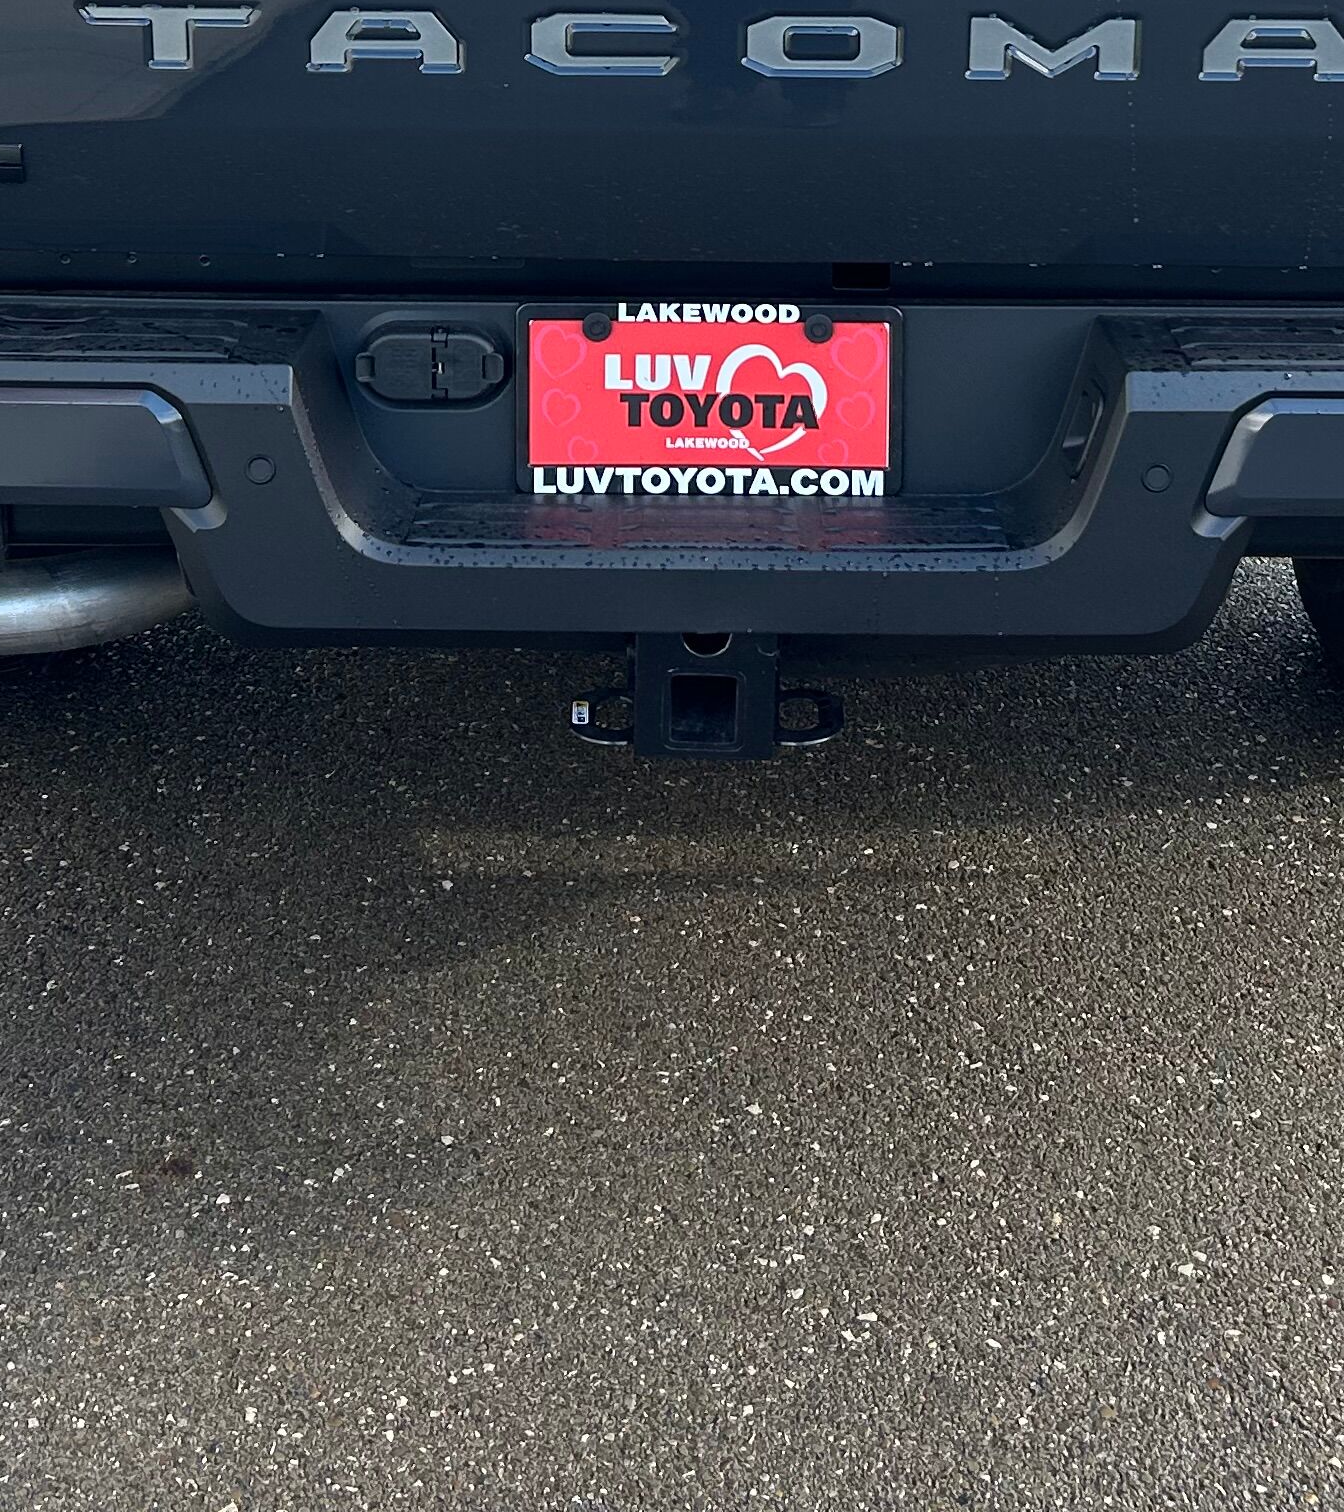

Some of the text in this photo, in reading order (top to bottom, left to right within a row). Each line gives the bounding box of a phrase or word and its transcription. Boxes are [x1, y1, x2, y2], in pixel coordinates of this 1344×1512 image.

[617, 302, 801, 324] LAKEWOOD
[604, 353, 712, 390] LUV
[619, 392, 820, 430] TOYOTA
[665, 437, 750, 449] LAKEWOOD
[532, 466, 885, 497] LUVTOYOTA.COM
